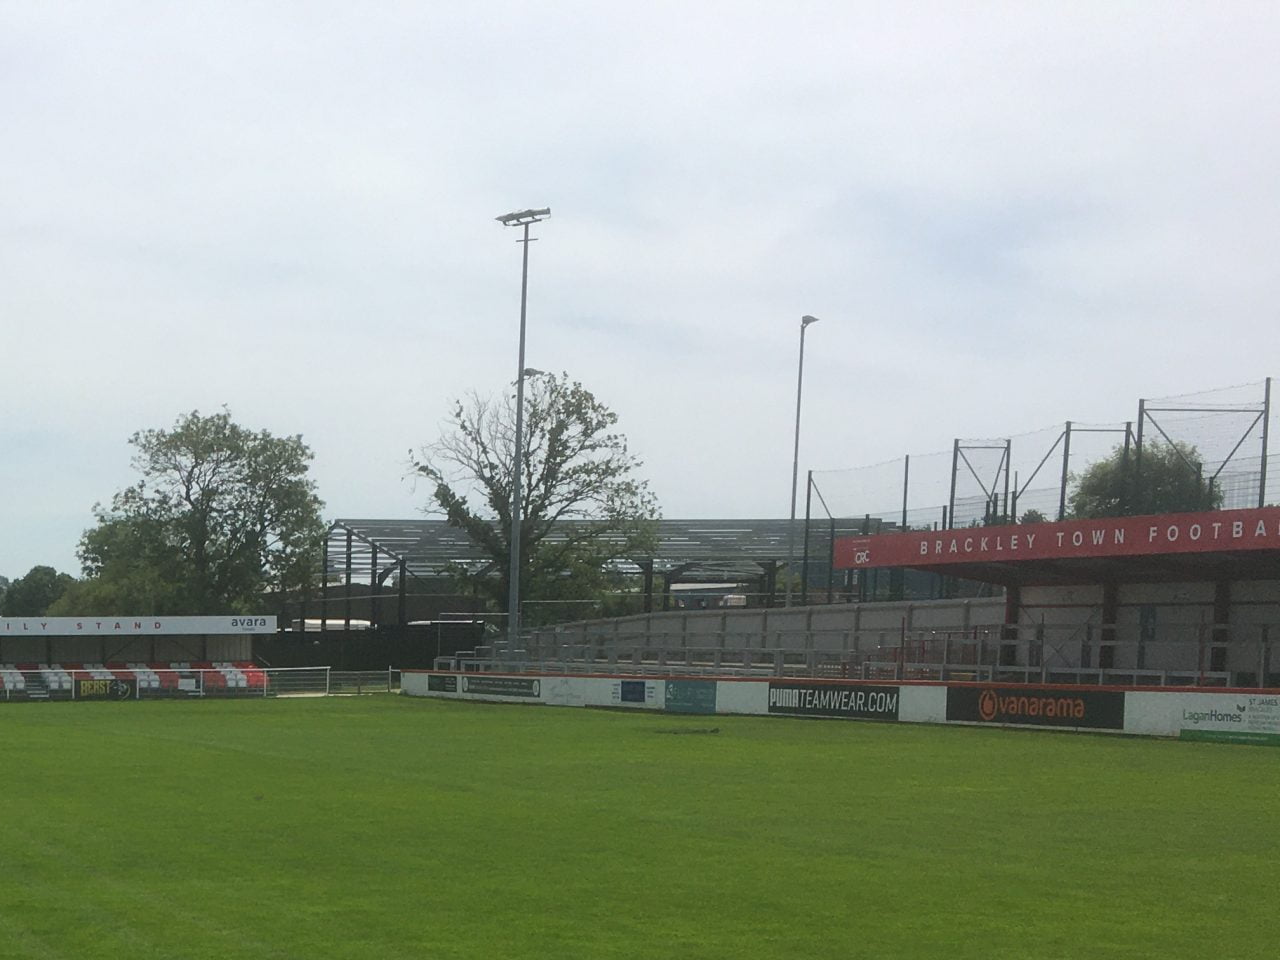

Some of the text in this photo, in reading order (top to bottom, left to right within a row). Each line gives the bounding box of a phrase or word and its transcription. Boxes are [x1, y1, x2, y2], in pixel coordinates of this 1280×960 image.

[919, 519, 1280, 555] BRACKLEY TOWN FOOTBA
[76, 622, 162, 631] STAND
[231, 618, 266, 627] avara
[80, 679, 111, 695] BEAST
[998, 696, 1085, 718] vanarama
[1183, 709, 1242, 724] LaganHomes
